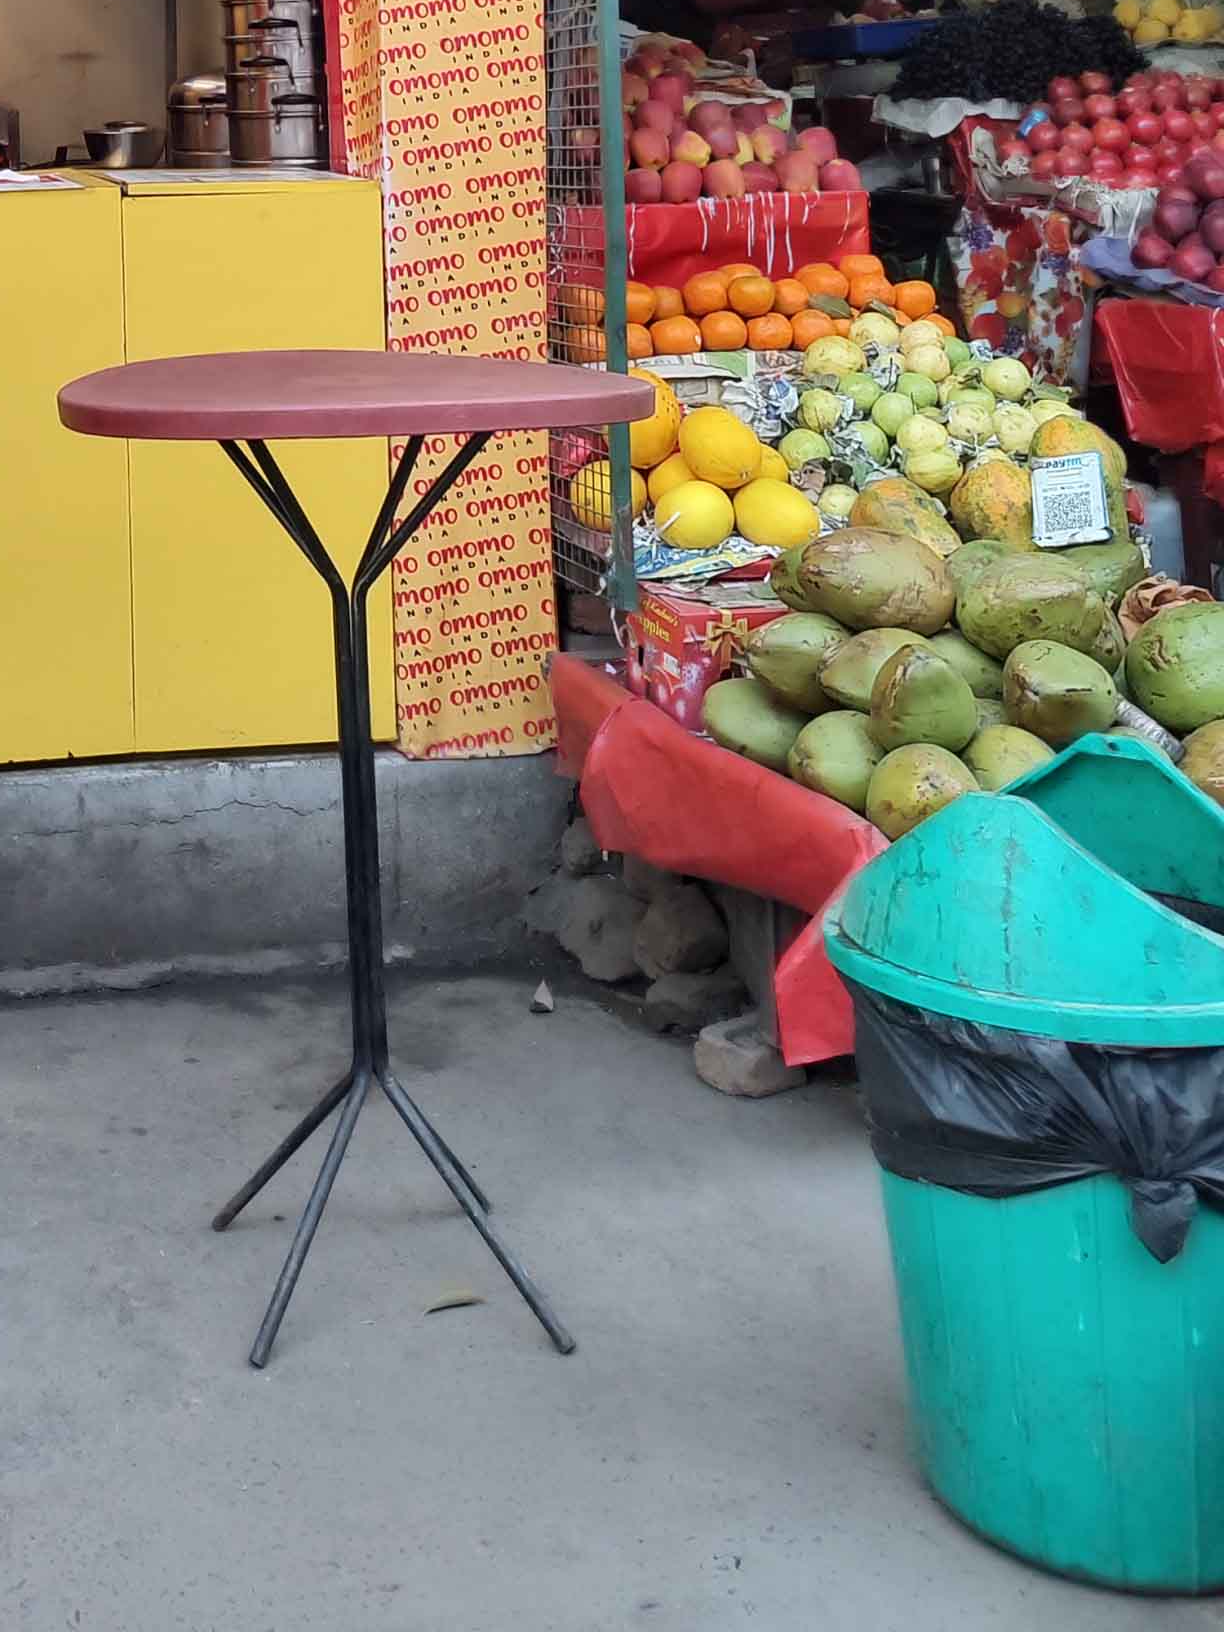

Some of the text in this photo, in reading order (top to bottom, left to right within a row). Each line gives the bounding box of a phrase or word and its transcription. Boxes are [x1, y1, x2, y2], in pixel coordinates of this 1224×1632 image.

[403, 88, 469, 104] INDIA
[416, 160, 482, 175] INDIA
[428, 227, 494, 245] INDIA
[440, 556, 505, 572] INDIA
[407, 670, 472, 690] INDIA
[463, 696, 530, 715] INDIA
